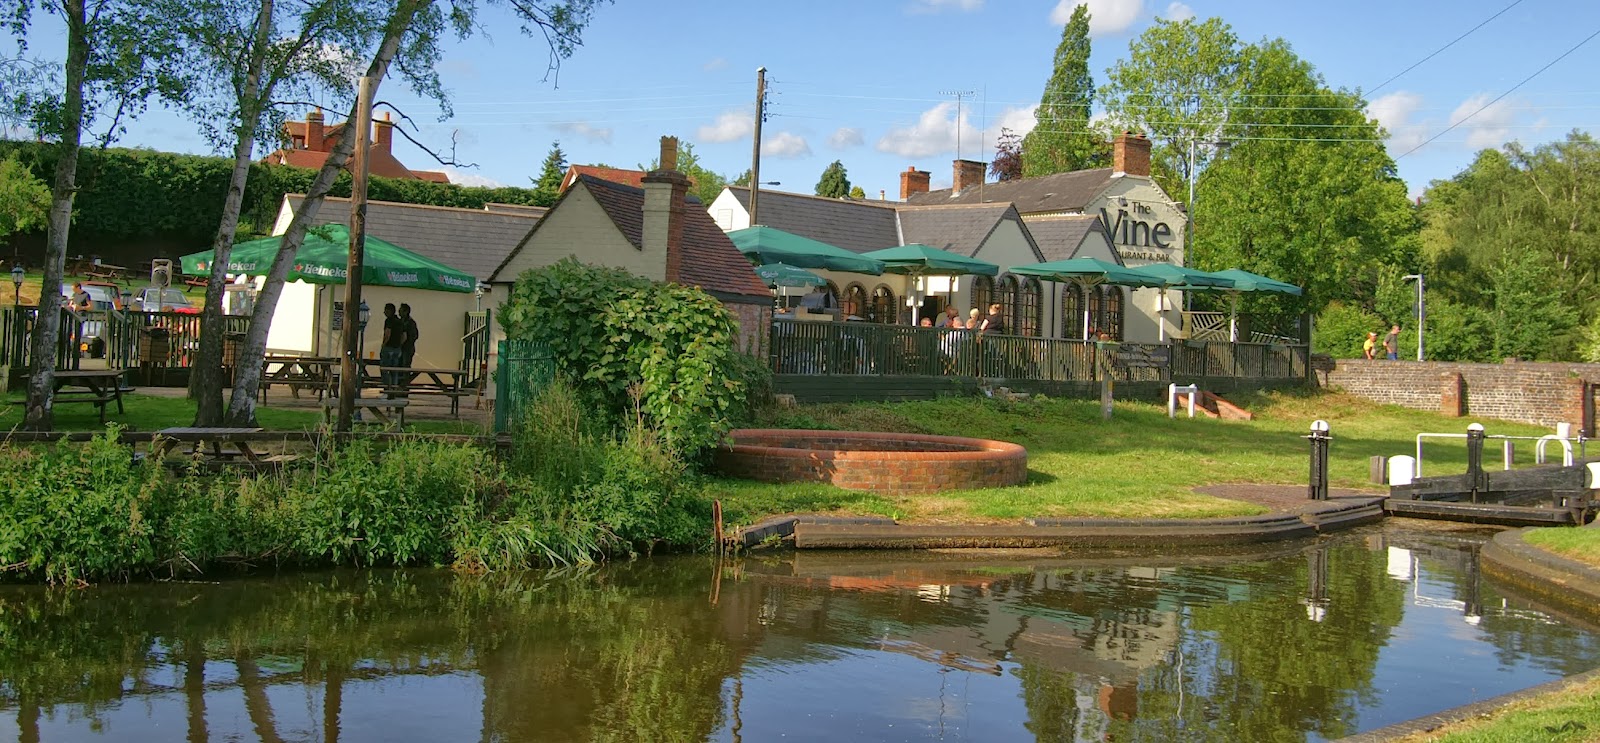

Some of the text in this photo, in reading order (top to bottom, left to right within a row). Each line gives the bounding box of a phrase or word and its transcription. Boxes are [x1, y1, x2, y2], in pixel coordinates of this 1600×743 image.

[1132, 201, 1151, 214] The
[1100, 207, 1171, 248] Vine
[1118, 250, 1170, 262] AURANT & BAR
[207, 260, 256, 271] Heken
[304, 263, 348, 278] Heineke
[391, 271, 419, 282] Heineken
[443, 275, 471, 288] Heineken
